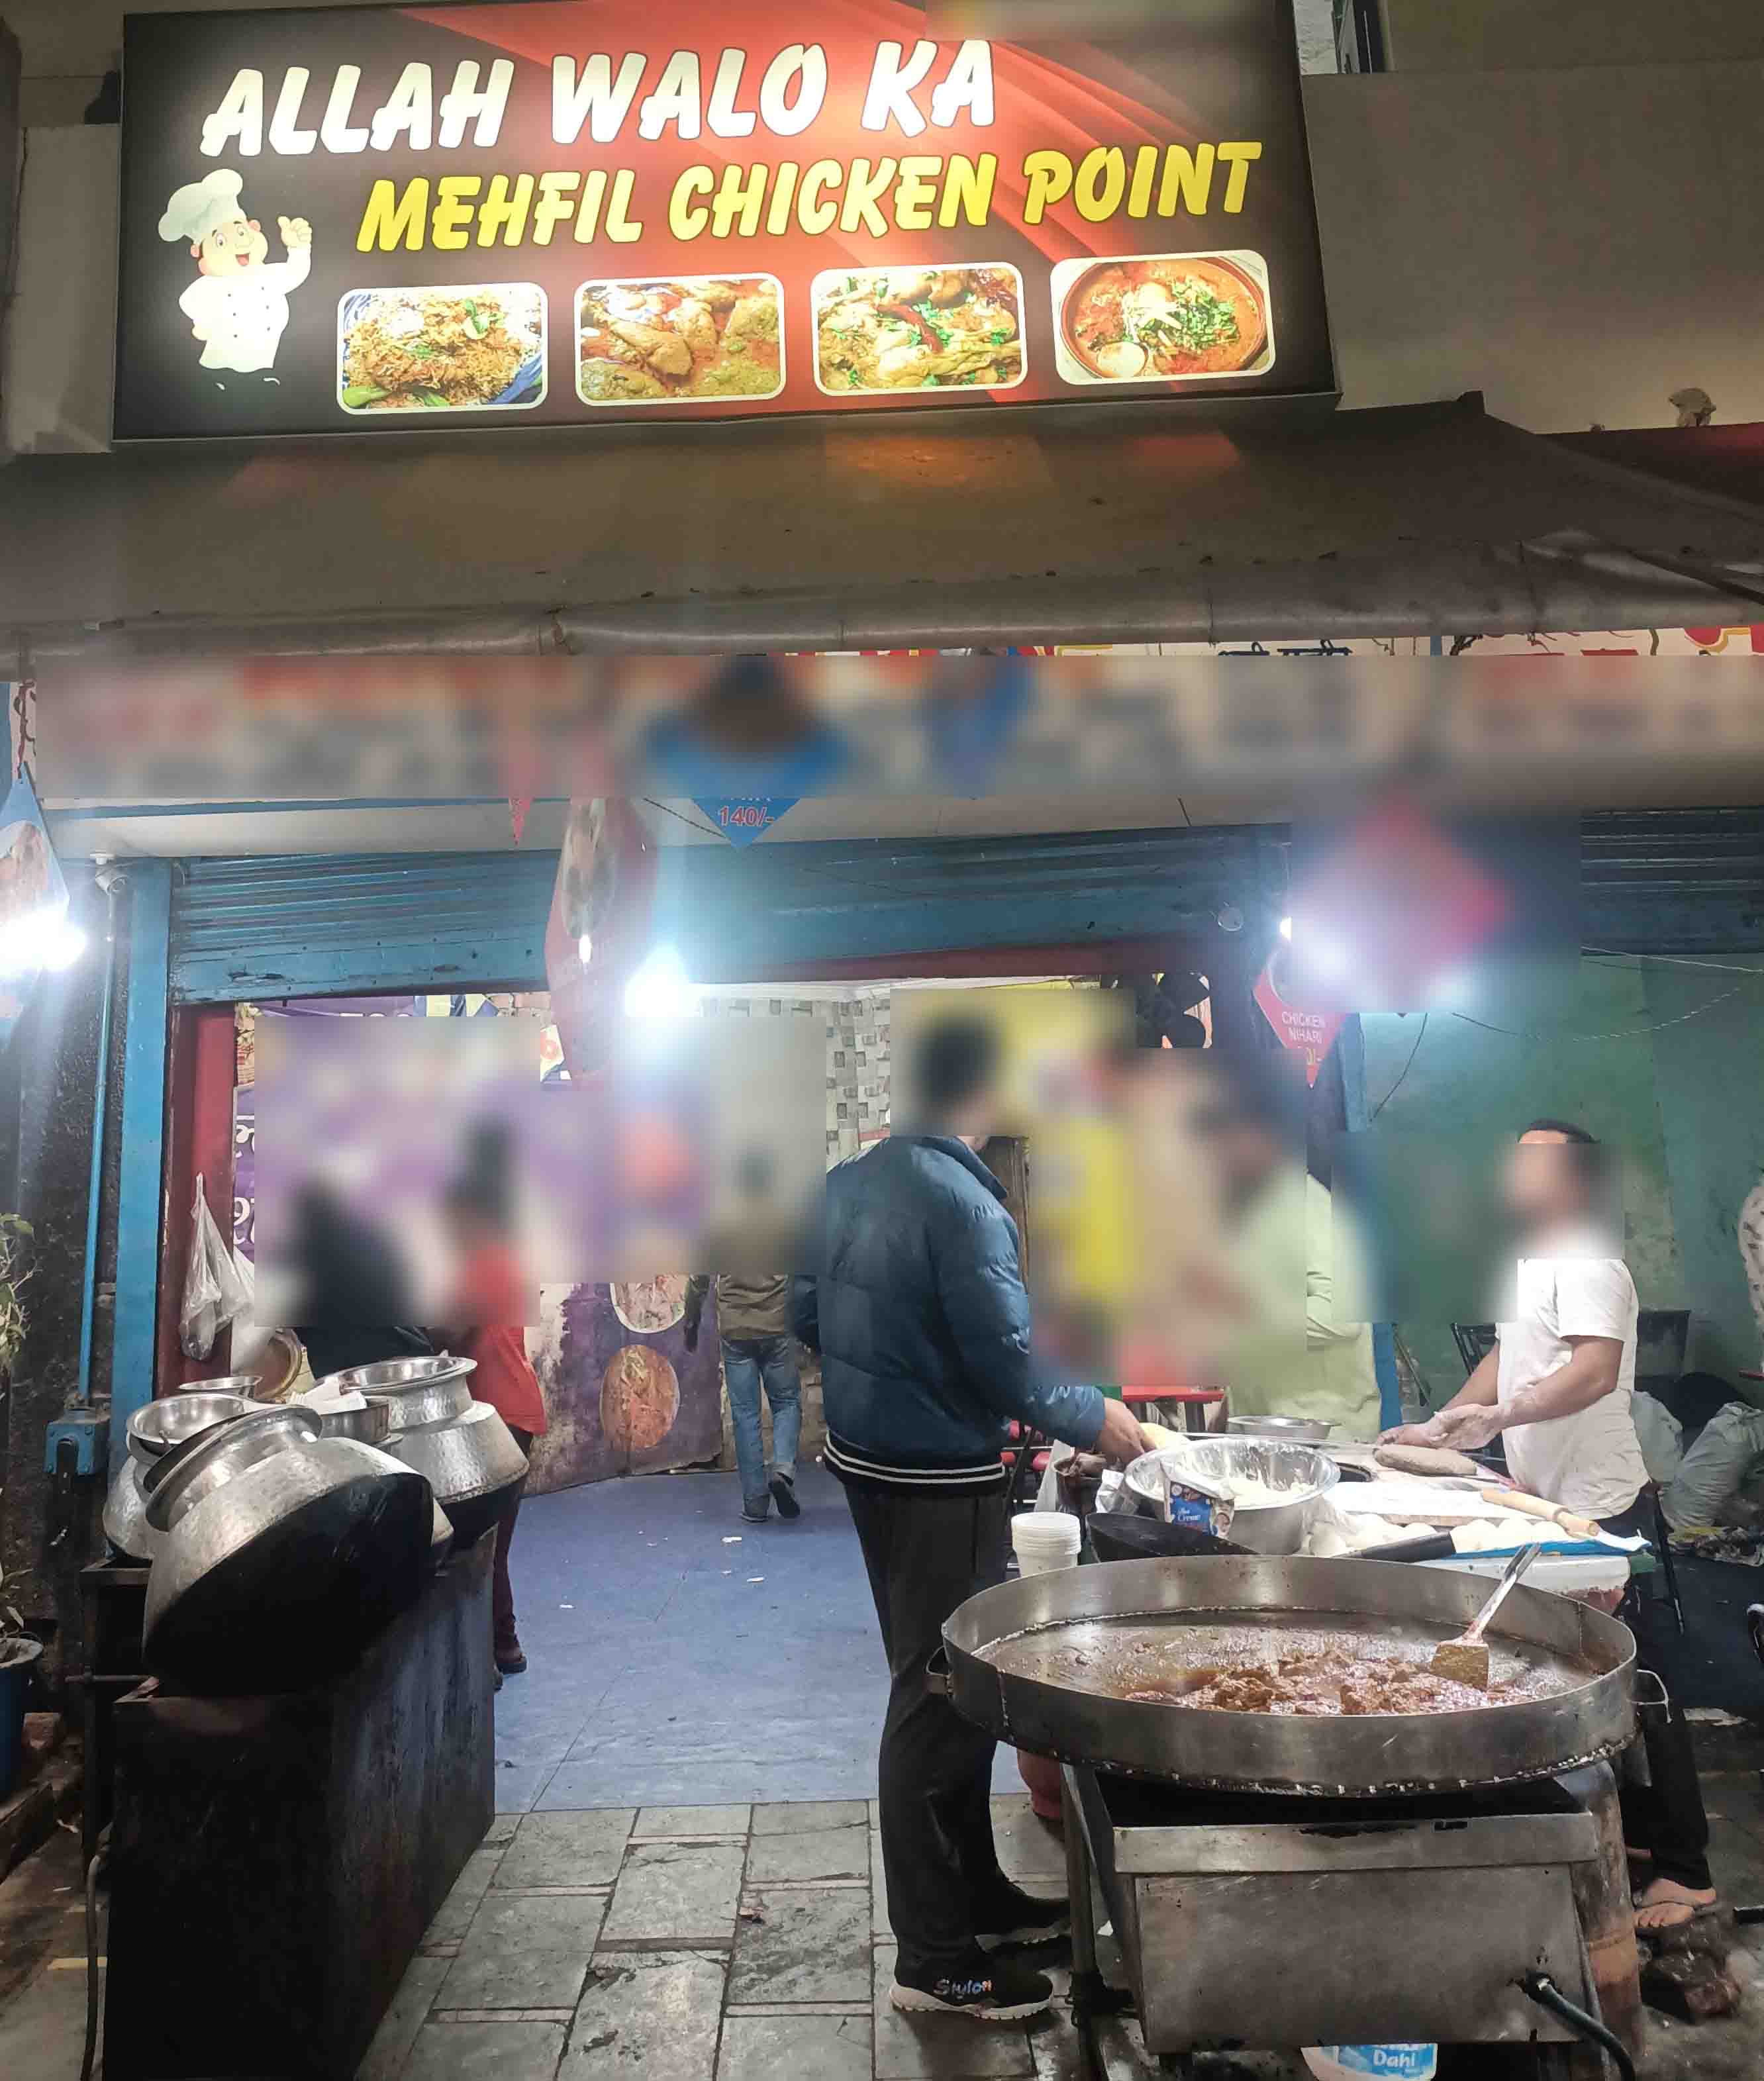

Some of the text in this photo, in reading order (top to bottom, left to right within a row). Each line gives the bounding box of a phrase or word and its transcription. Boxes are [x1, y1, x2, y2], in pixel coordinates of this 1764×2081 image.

[199, 37, 995, 157] ALLAH WALO KA
[355, 141, 1263, 253] MEHFIL CHICKEN POINT
[718, 805, 775, 827] 140/-
